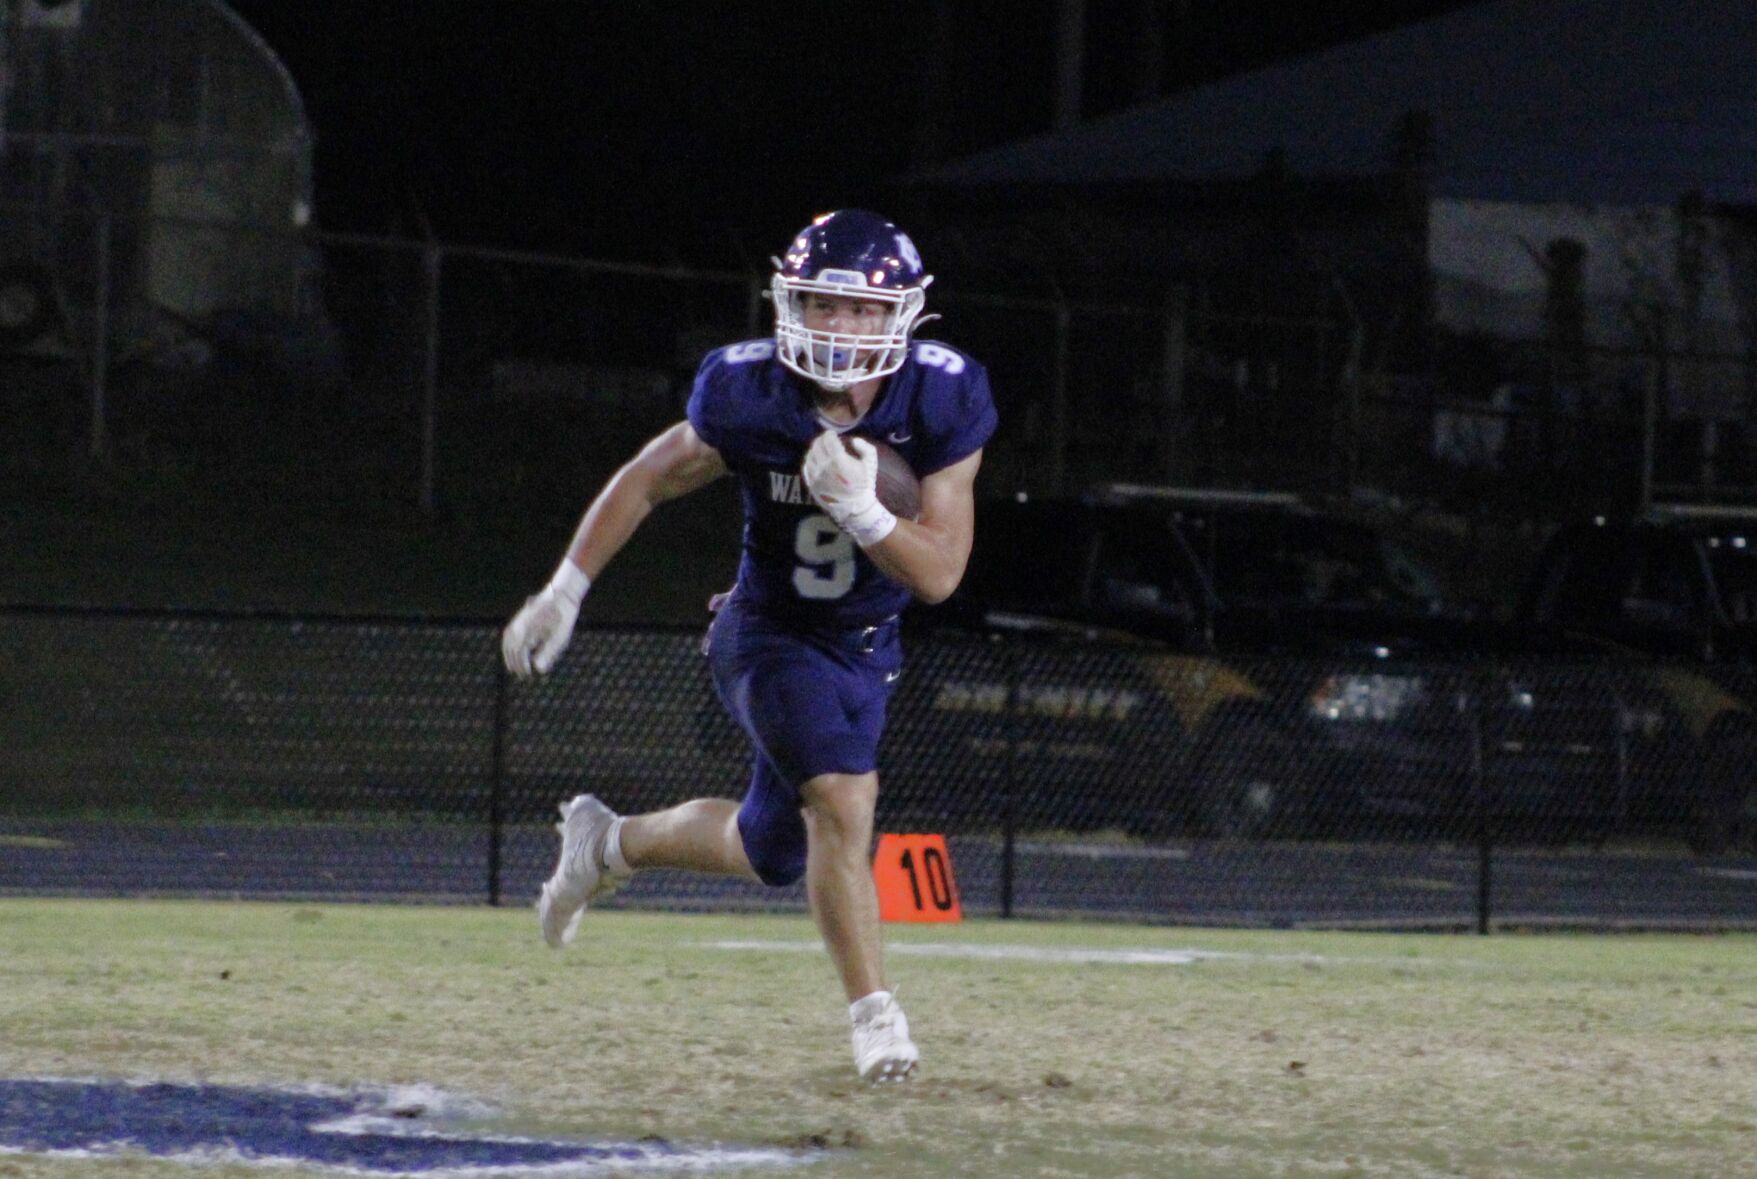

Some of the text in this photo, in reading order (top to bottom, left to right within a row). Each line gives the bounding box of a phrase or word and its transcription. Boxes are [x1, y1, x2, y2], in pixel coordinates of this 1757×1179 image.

[725, 342, 775, 364] 9
[916, 344, 965, 374] 9
[769, 471, 814, 505] WA
[793, 514, 856, 599] 9
[901, 847, 952, 911] 10
